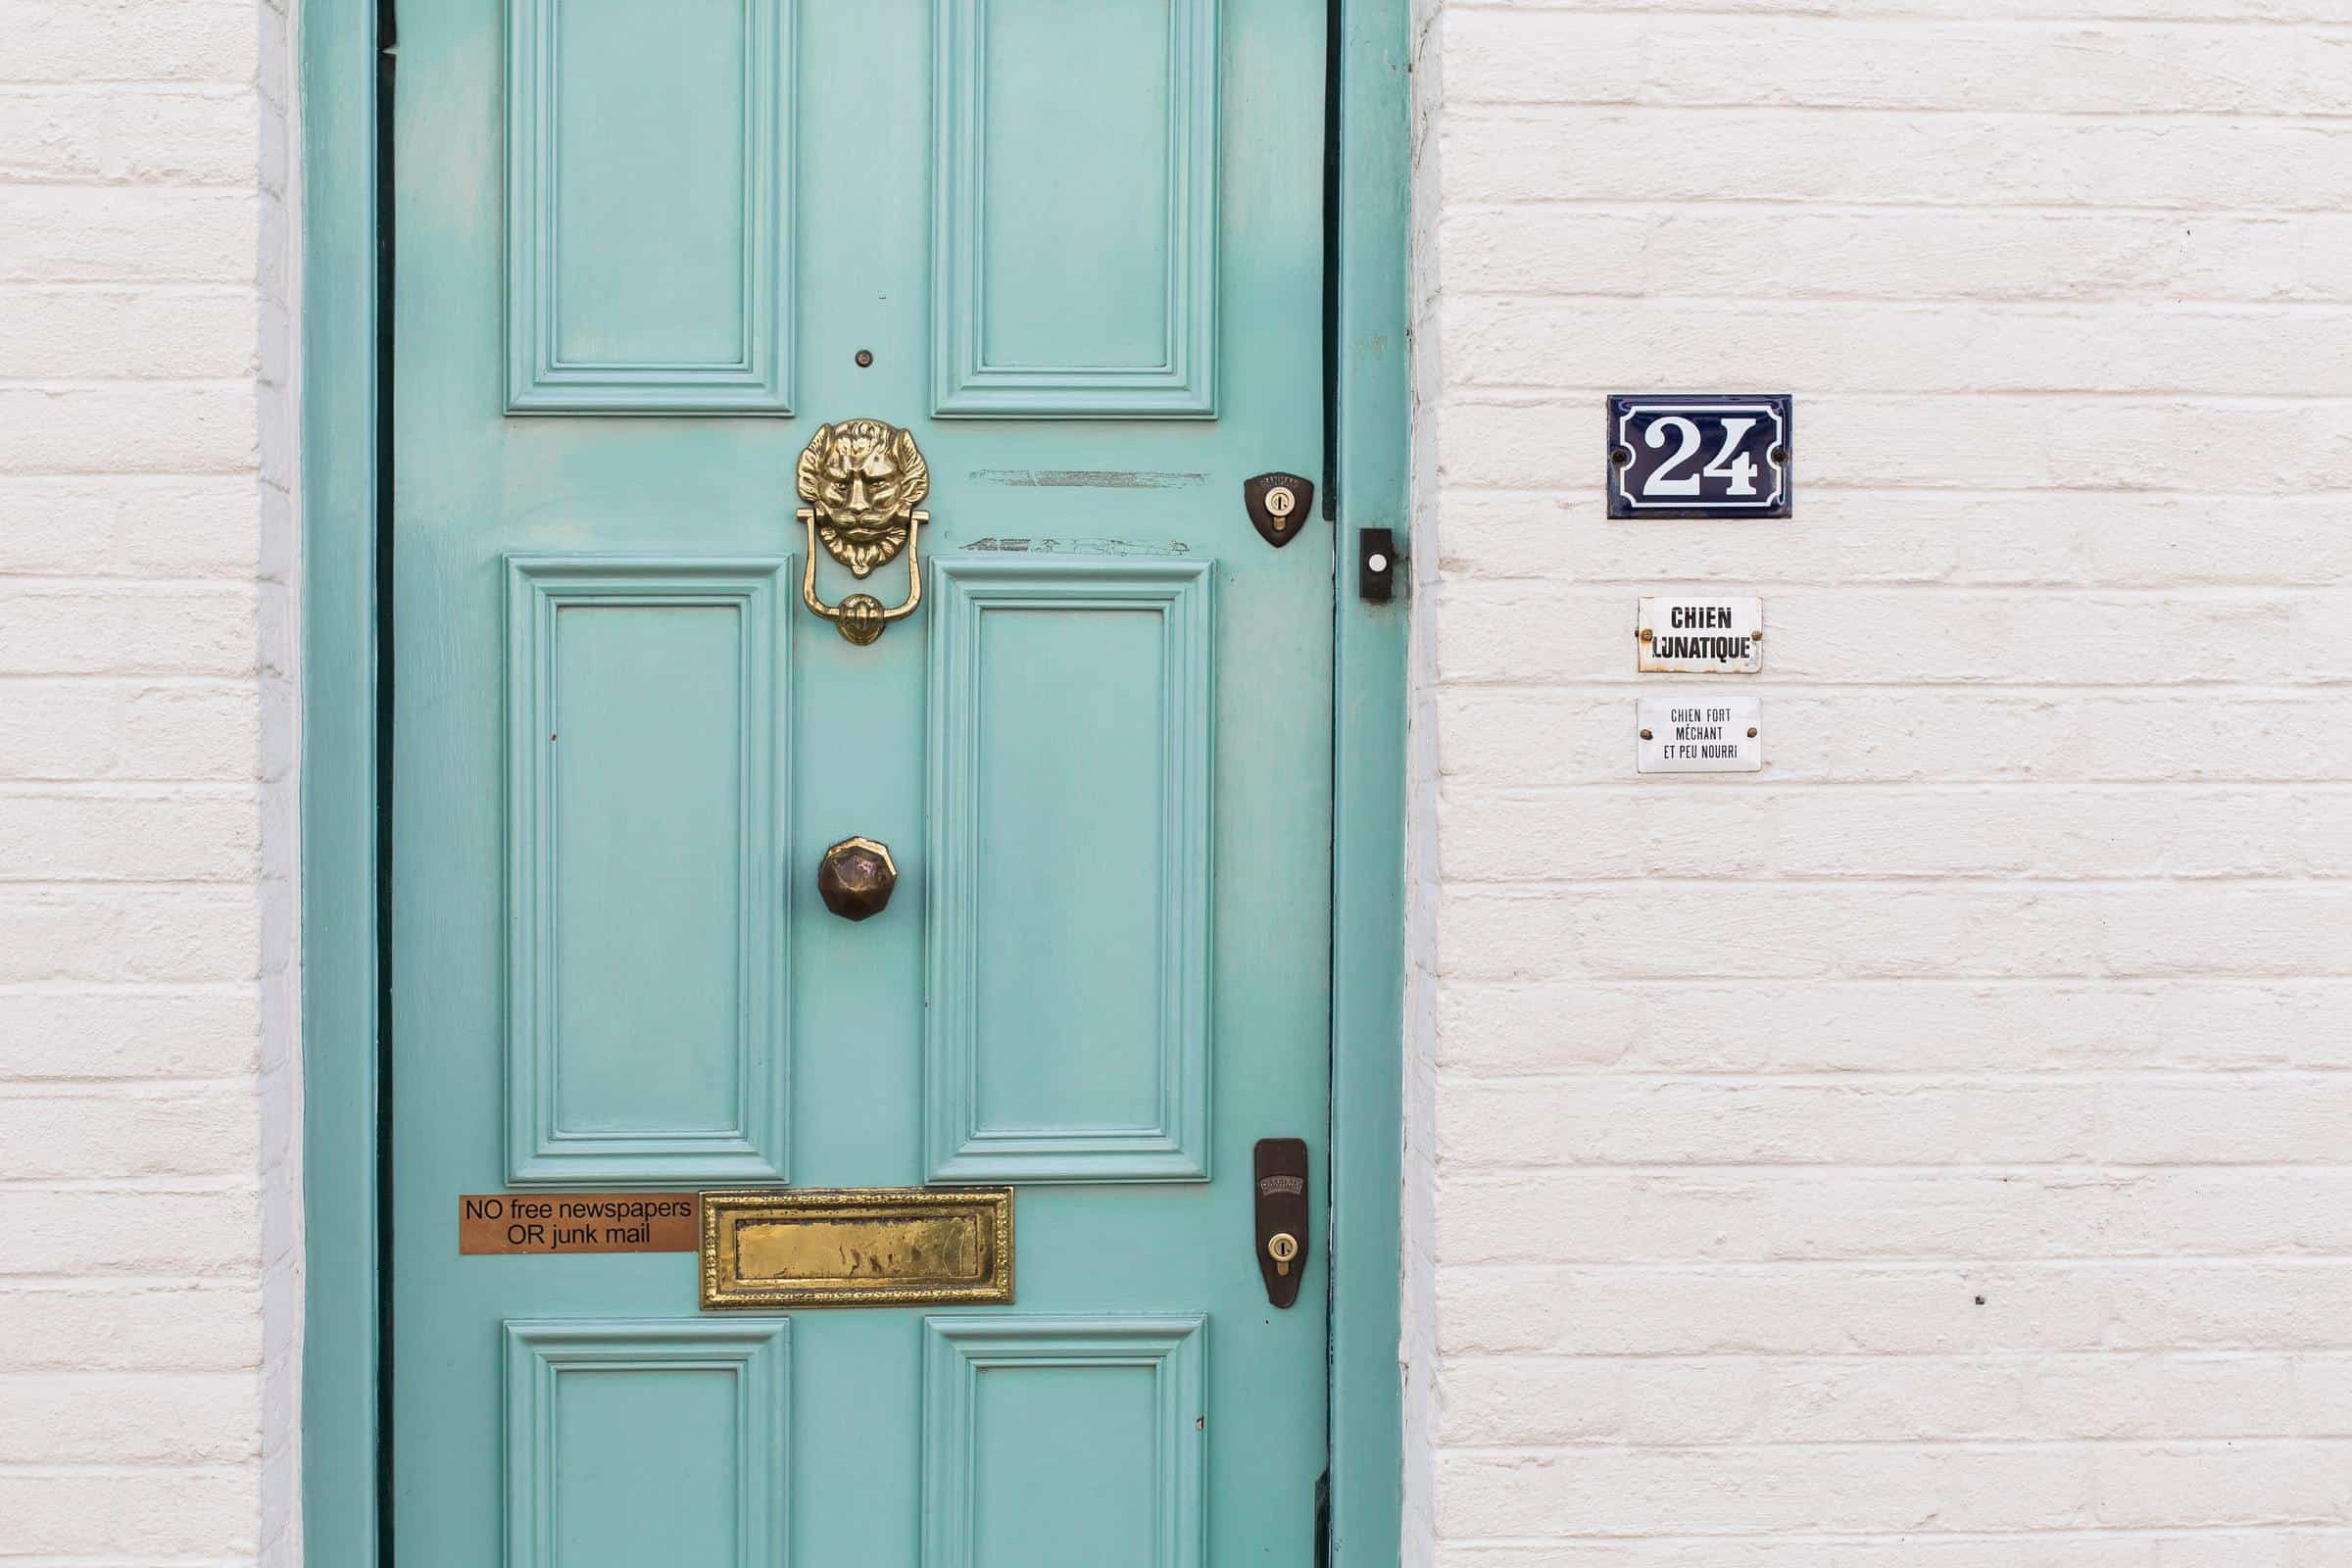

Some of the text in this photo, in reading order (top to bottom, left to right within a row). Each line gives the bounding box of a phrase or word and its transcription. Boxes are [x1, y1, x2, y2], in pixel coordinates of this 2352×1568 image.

[1642, 416, 1757, 495] 24
[1671, 607, 1732, 628] CHIEN
[1653, 636, 1750, 662] LUNATIQUE
[1671, 709, 1731, 721] CHIEN FORT
[1676, 723, 1723, 741] MÉCHANT
[1664, 745, 1738, 759] ET PEU NOURRI
[466, 1200, 691, 1221] NO free newspapers
[508, 1223, 651, 1249] OR junk mail
